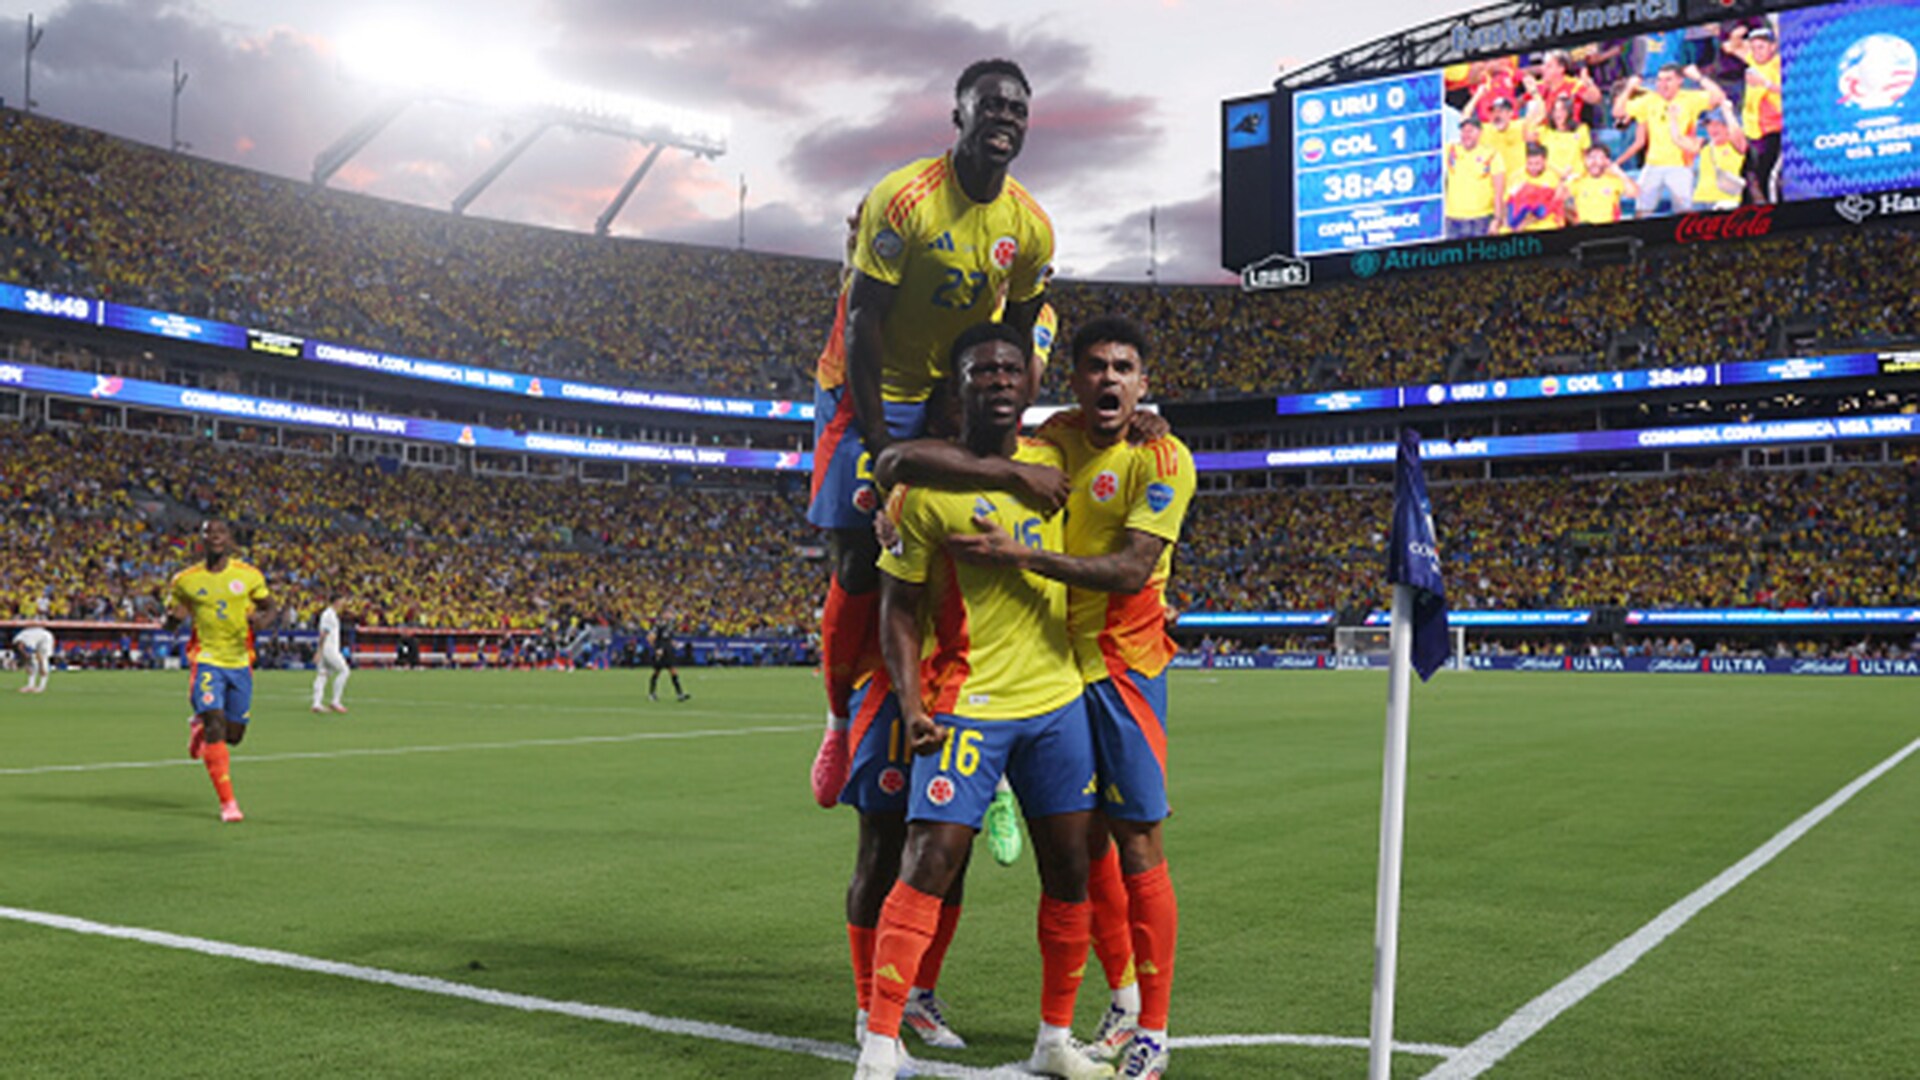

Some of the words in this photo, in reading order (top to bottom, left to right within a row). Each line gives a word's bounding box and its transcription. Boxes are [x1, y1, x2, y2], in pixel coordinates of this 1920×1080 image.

[1523, 10, 1554, 40] of
[1556, 0, 1679, 35] America
[1331, 93, 1377, 117] URU
[1387, 87, 1405, 110] 0
[1331, 133, 1377, 156] COL
[1391, 126, 1405, 150] 1
[1814, 131, 1860, 149] COPA
[1323, 166, 1415, 202] 38:49
[1318, 221, 1355, 237] COPA
[1384, 247, 1463, 270] Atrium
[1466, 236, 1543, 261] Health
[24, 289, 89, 319] 38:49
[1451, 382, 1486, 399] URU
[1493, 380, 1507, 397] 0
[1566, 376, 1604, 392] COL
[1612, 372, 1623, 389] 1
[1648, 366, 1707, 386] 38:49
[216, 599, 228, 620] 2
[1214, 656, 1255, 668] ULTRA
[1573, 658, 1624, 670] ULTRA
[1712, 659, 1766, 672] ULTRA
[1860, 660, 1918, 673] ULTRA
[201, 672, 213, 691] 2
[939, 726, 983, 777] 16
